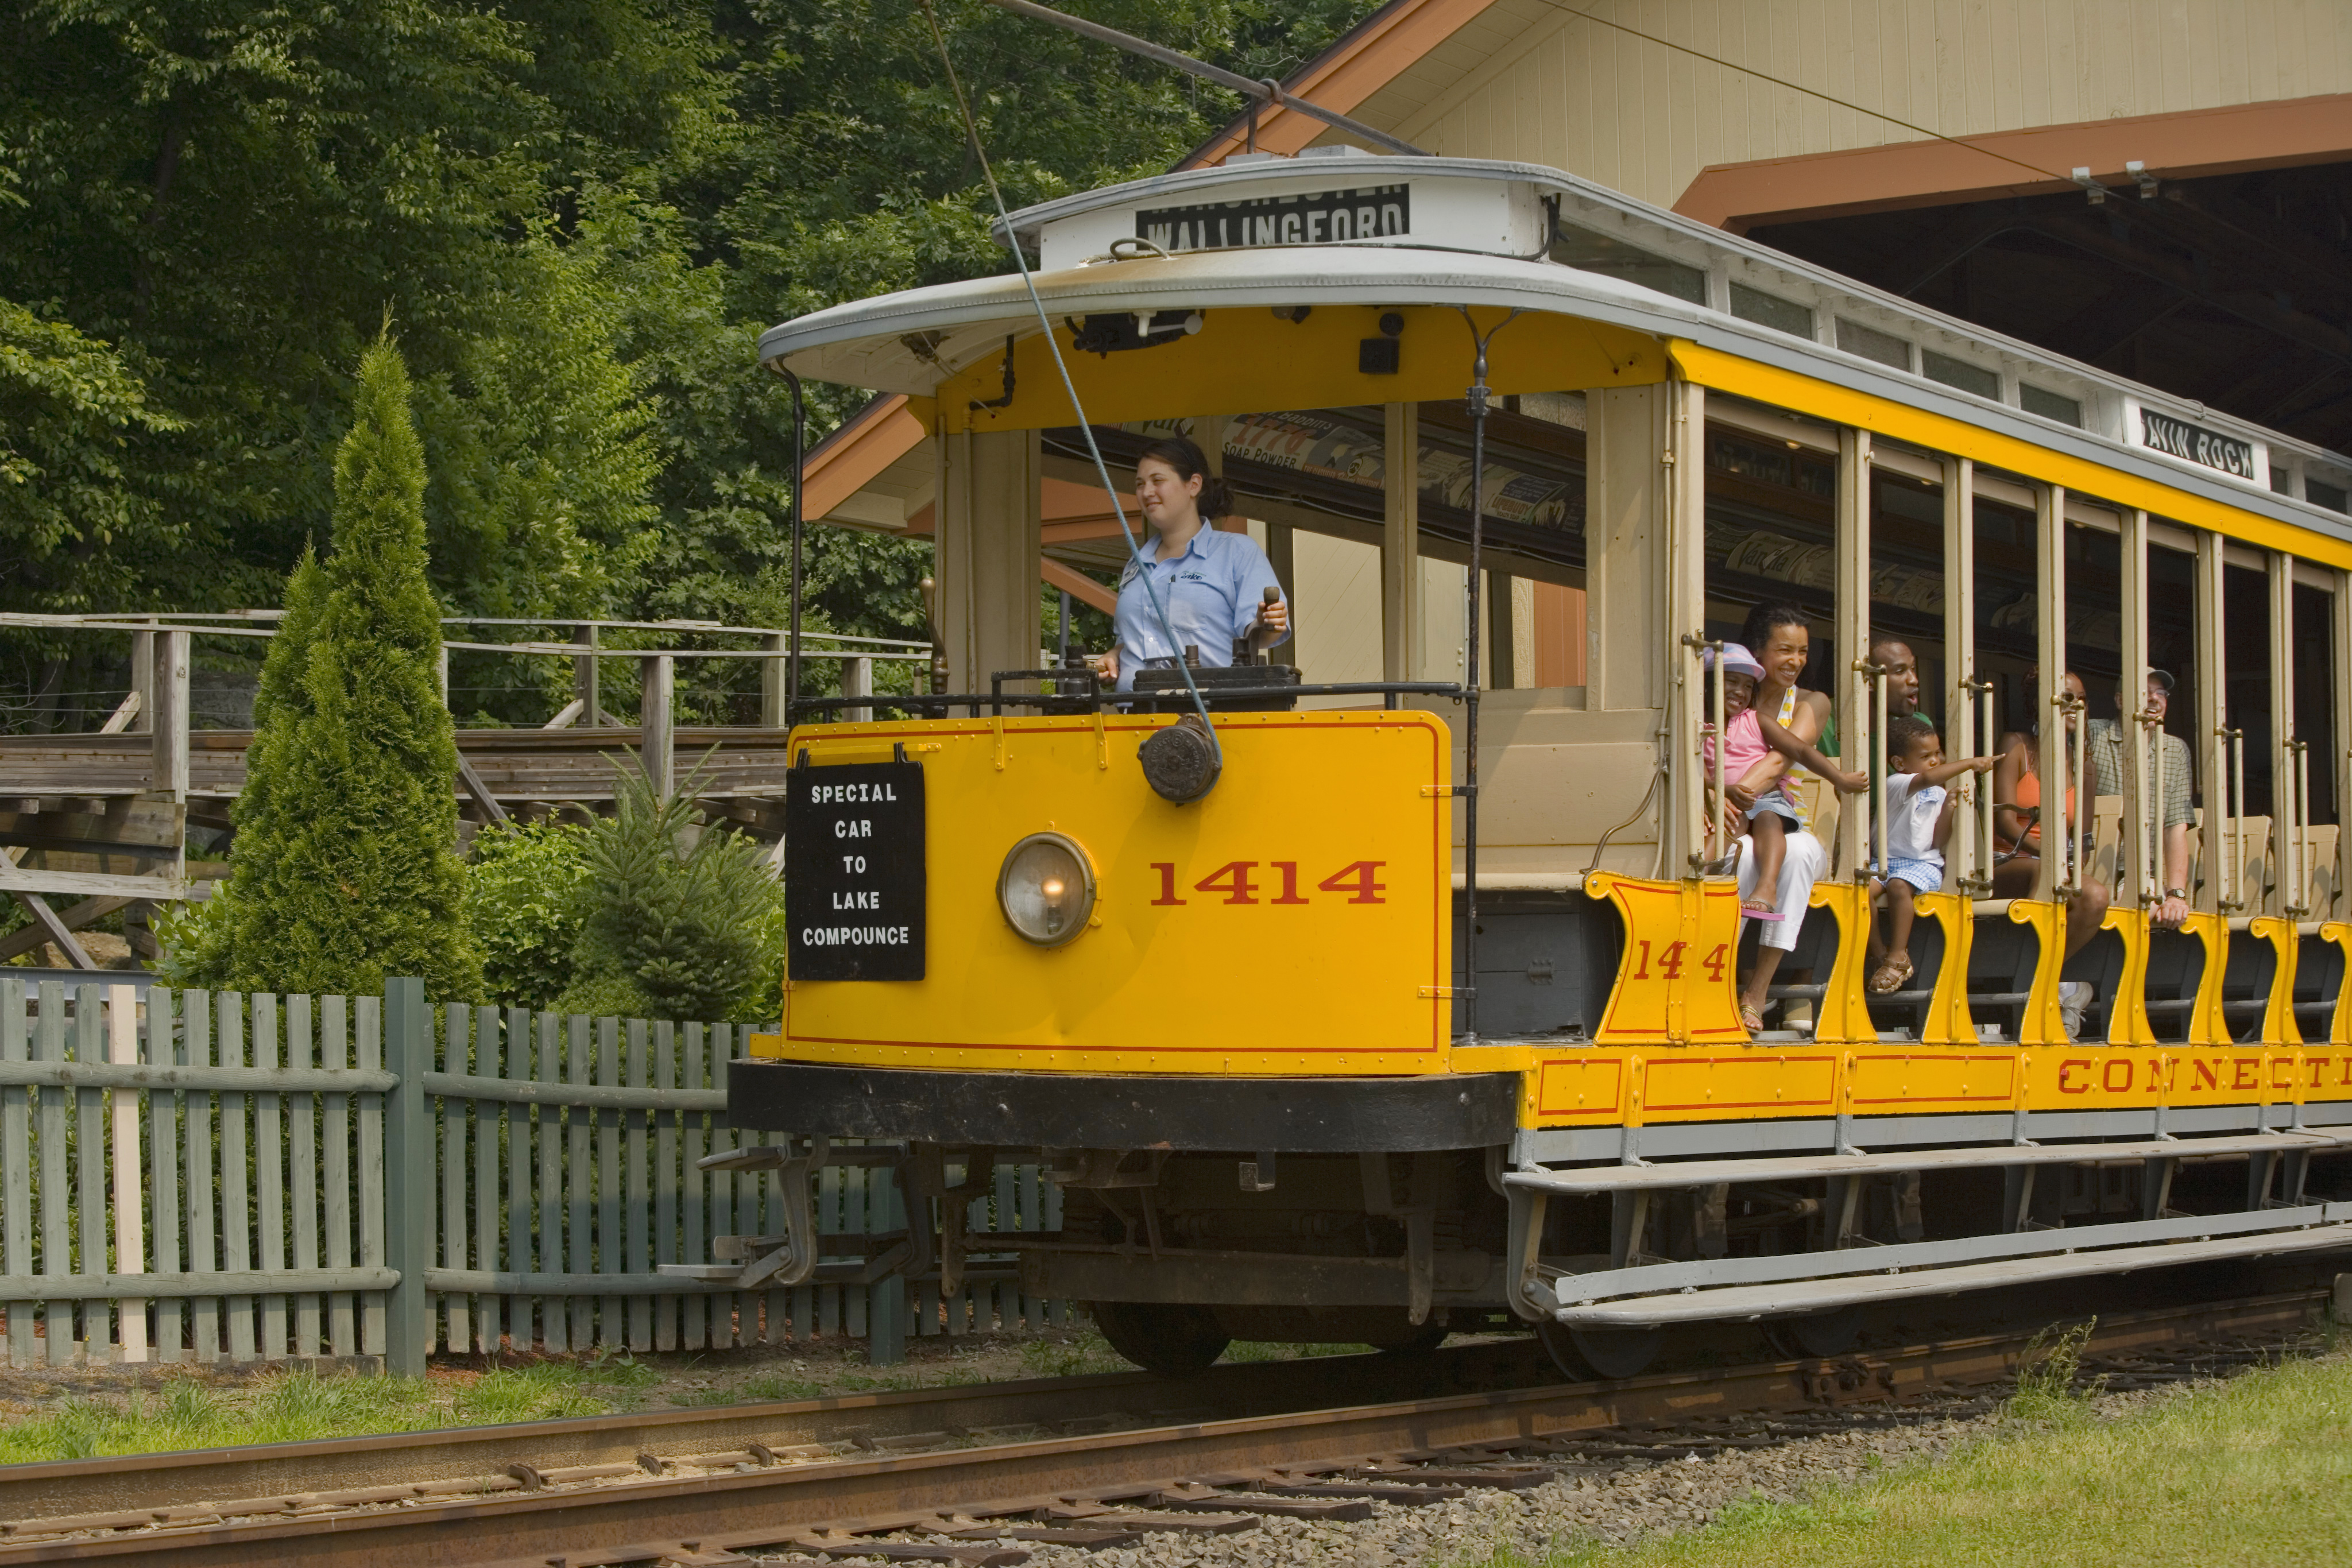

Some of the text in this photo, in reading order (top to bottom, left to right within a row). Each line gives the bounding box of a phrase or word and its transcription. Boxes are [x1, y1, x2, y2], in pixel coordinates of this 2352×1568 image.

[1232, 413, 1317, 455] 1776
[1222, 442, 1297, 470] SOAP POWDER
[2197, 433, 2252, 477] ROCK
[1491, 496, 1532, 515] LIFEBUOY
[811, 783, 896, 803] SPECIAL
[835, 820, 872, 838] CAR
[843, 856, 866, 873] TO
[1150, 861, 1386, 906] 1414
[833, 892, 879, 909] LAKE
[803, 926, 908, 946] COMPOUNCE
